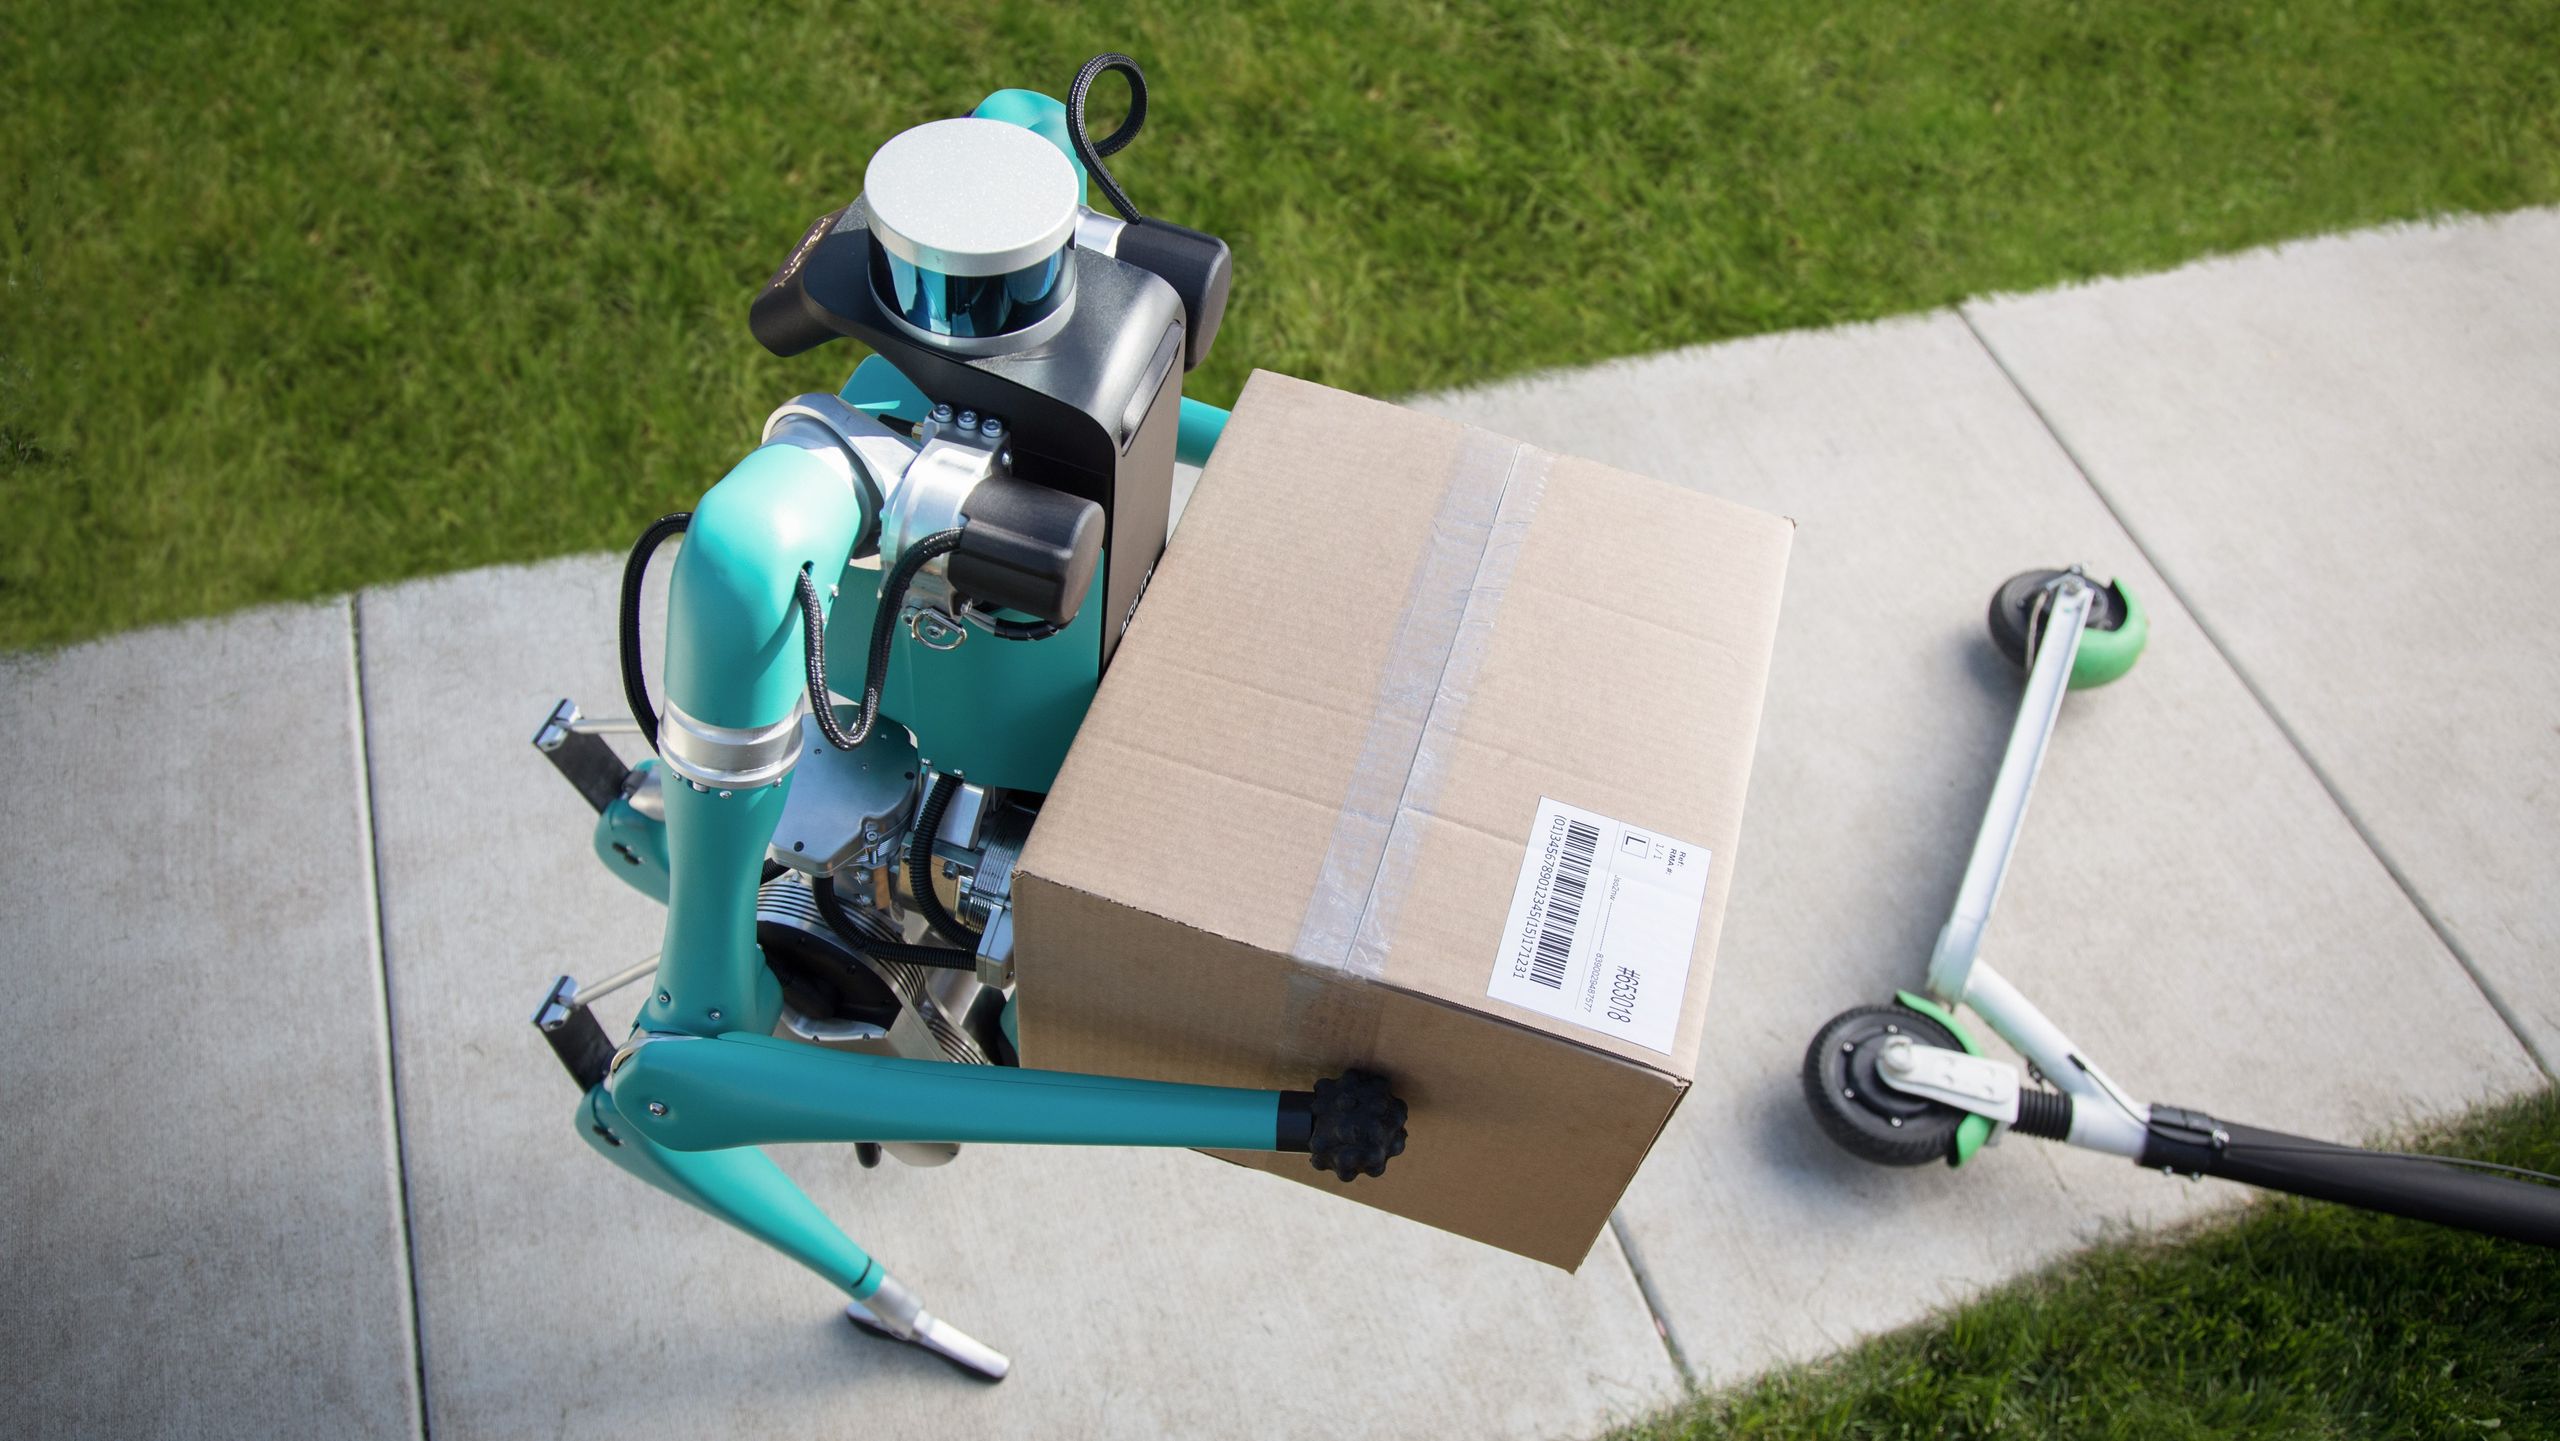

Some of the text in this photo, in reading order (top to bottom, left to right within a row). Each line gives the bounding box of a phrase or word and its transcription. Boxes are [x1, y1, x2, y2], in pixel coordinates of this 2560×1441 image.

[1625, 835, 1646, 845] L
[1653, 843, 1664, 859] 1/1
[1668, 848, 1677, 866] RMA
[1678, 851, 1687, 867] Ref:
[1512, 814, 1567, 980] (01)3456789012345(15)171231
[1607, 965, 1641, 1023] #653018
